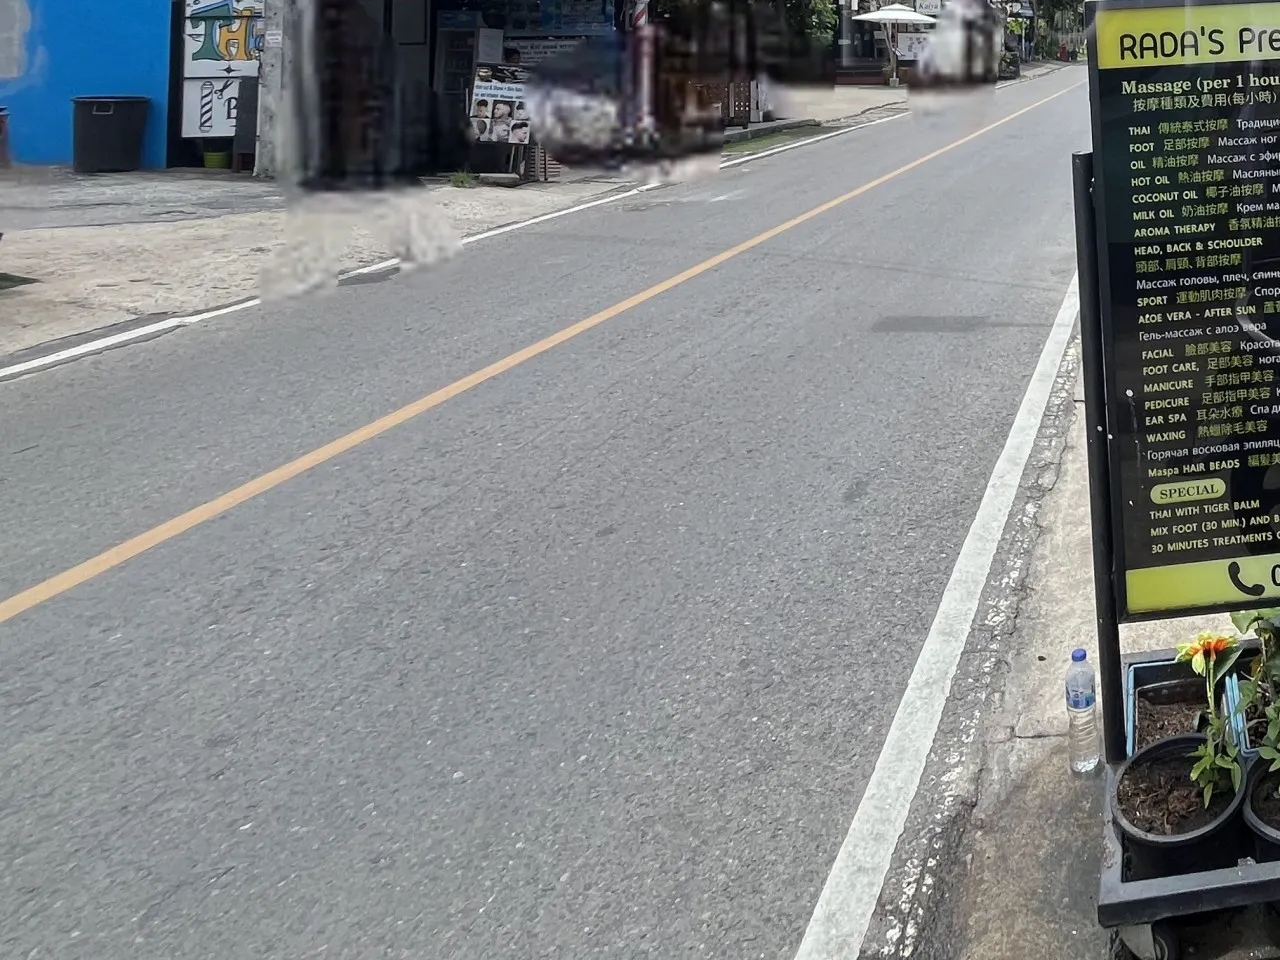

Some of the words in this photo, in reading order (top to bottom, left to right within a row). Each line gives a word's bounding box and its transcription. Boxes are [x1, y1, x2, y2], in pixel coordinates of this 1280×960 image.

[1119, 25, 1225, 61] RADA'S
[1121, 80, 1192, 95] Massage
[1196, 77, 1229, 93] (per
[1128, 126, 1151, 136] THAI
[1129, 142, 1155, 153] FOOT
[1163, 136, 1210, 151] 足部按摩
[1218, 136, 1258, 147] Массаж
[1260, 135, 1278, 144] ног
[1130, 160, 1146, 170] OIL
[1152, 153, 1199, 169] 精油按摩
[1207, 154, 1247, 164] Массаж
[1131, 176, 1151, 187] HOT
[1154, 175, 1170, 185] OIL
[1131, 191, 1179, 204] COCONUT
[1182, 190, 1199, 200] OIL
[1205, 183, 1264, 198] 椰子油按摩
[1132, 210, 1156, 221] MILK
[1159, 209, 1175, 219] OIL
[1181, 202, 1229, 218] 奶油按摩
[1236, 202, 1264, 215] Крем
[1134, 226, 1171, 238] AROMA
[1173, 222, 1216, 234] THERAPY
[1134, 245, 1163, 256] HEAD,
[1166, 242, 1192, 253] BACK
[1207, 237, 1263, 250] SCHOULDER
[1136, 279, 1177, 290] Массаж
[1179, 275, 1220, 286] головы,
[1222, 273, 1250, 282] плеч,
[1137, 295, 1168, 307] SPORT
[1138, 313, 1163, 324] ALOE
[1166, 311, 1192, 321] VERA
[1204, 307, 1233, 318] AFTER
[1235, 305, 1256, 315] SUN
[1139, 328, 1204, 342] Гель-массаж
[1215, 320, 1241, 335] алоэ
[1141, 348, 1174, 360] FACIAL
[1142, 364, 1169, 376] FOOT
[1171, 361, 1200, 373] CARE,
[1207, 354, 1254, 370] 足部美容
[1143, 379, 1194, 393] MANICURE
[1204, 369, 1274, 388] 手部指甲美容
[1144, 396, 1190, 410] PEDICURE
[1201, 386, 1271, 405] 足部指甲美容
[1145, 415, 1165, 426] EAR
[1168, 413, 1187, 423] SPA
[1250, 404, 1270, 415] Спа
[1146, 430, 1186, 443] WAXING
[1147, 448, 1189, 462] Горячая
[1192, 442, 1240, 456] восковая
[1148, 467, 1179, 478] Maspa
[1182, 462, 1206, 474] HAIR
[1209, 458, 1240, 471] BEADS
[1159, 484, 1219, 500] SPECIAL
[1149, 509, 1172, 520] THAI
[1175, 505, 1200, 517] WITH
[1203, 502, 1230, 514] TIGER
[1233, 499, 1260, 511] BALM
[1150, 526, 1169, 537] MIX
[1172, 522, 1198, 534] FOOT
[1201, 520, 1218, 533] (30
[1221, 517, 1246, 529] MIN.)
[1249, 515, 1271, 526] AND
[1151, 543, 1164, 554] 30
[1167, 538, 1209, 552] MINUTES
[1212, 531, 1273, 547] TREATMENTS
